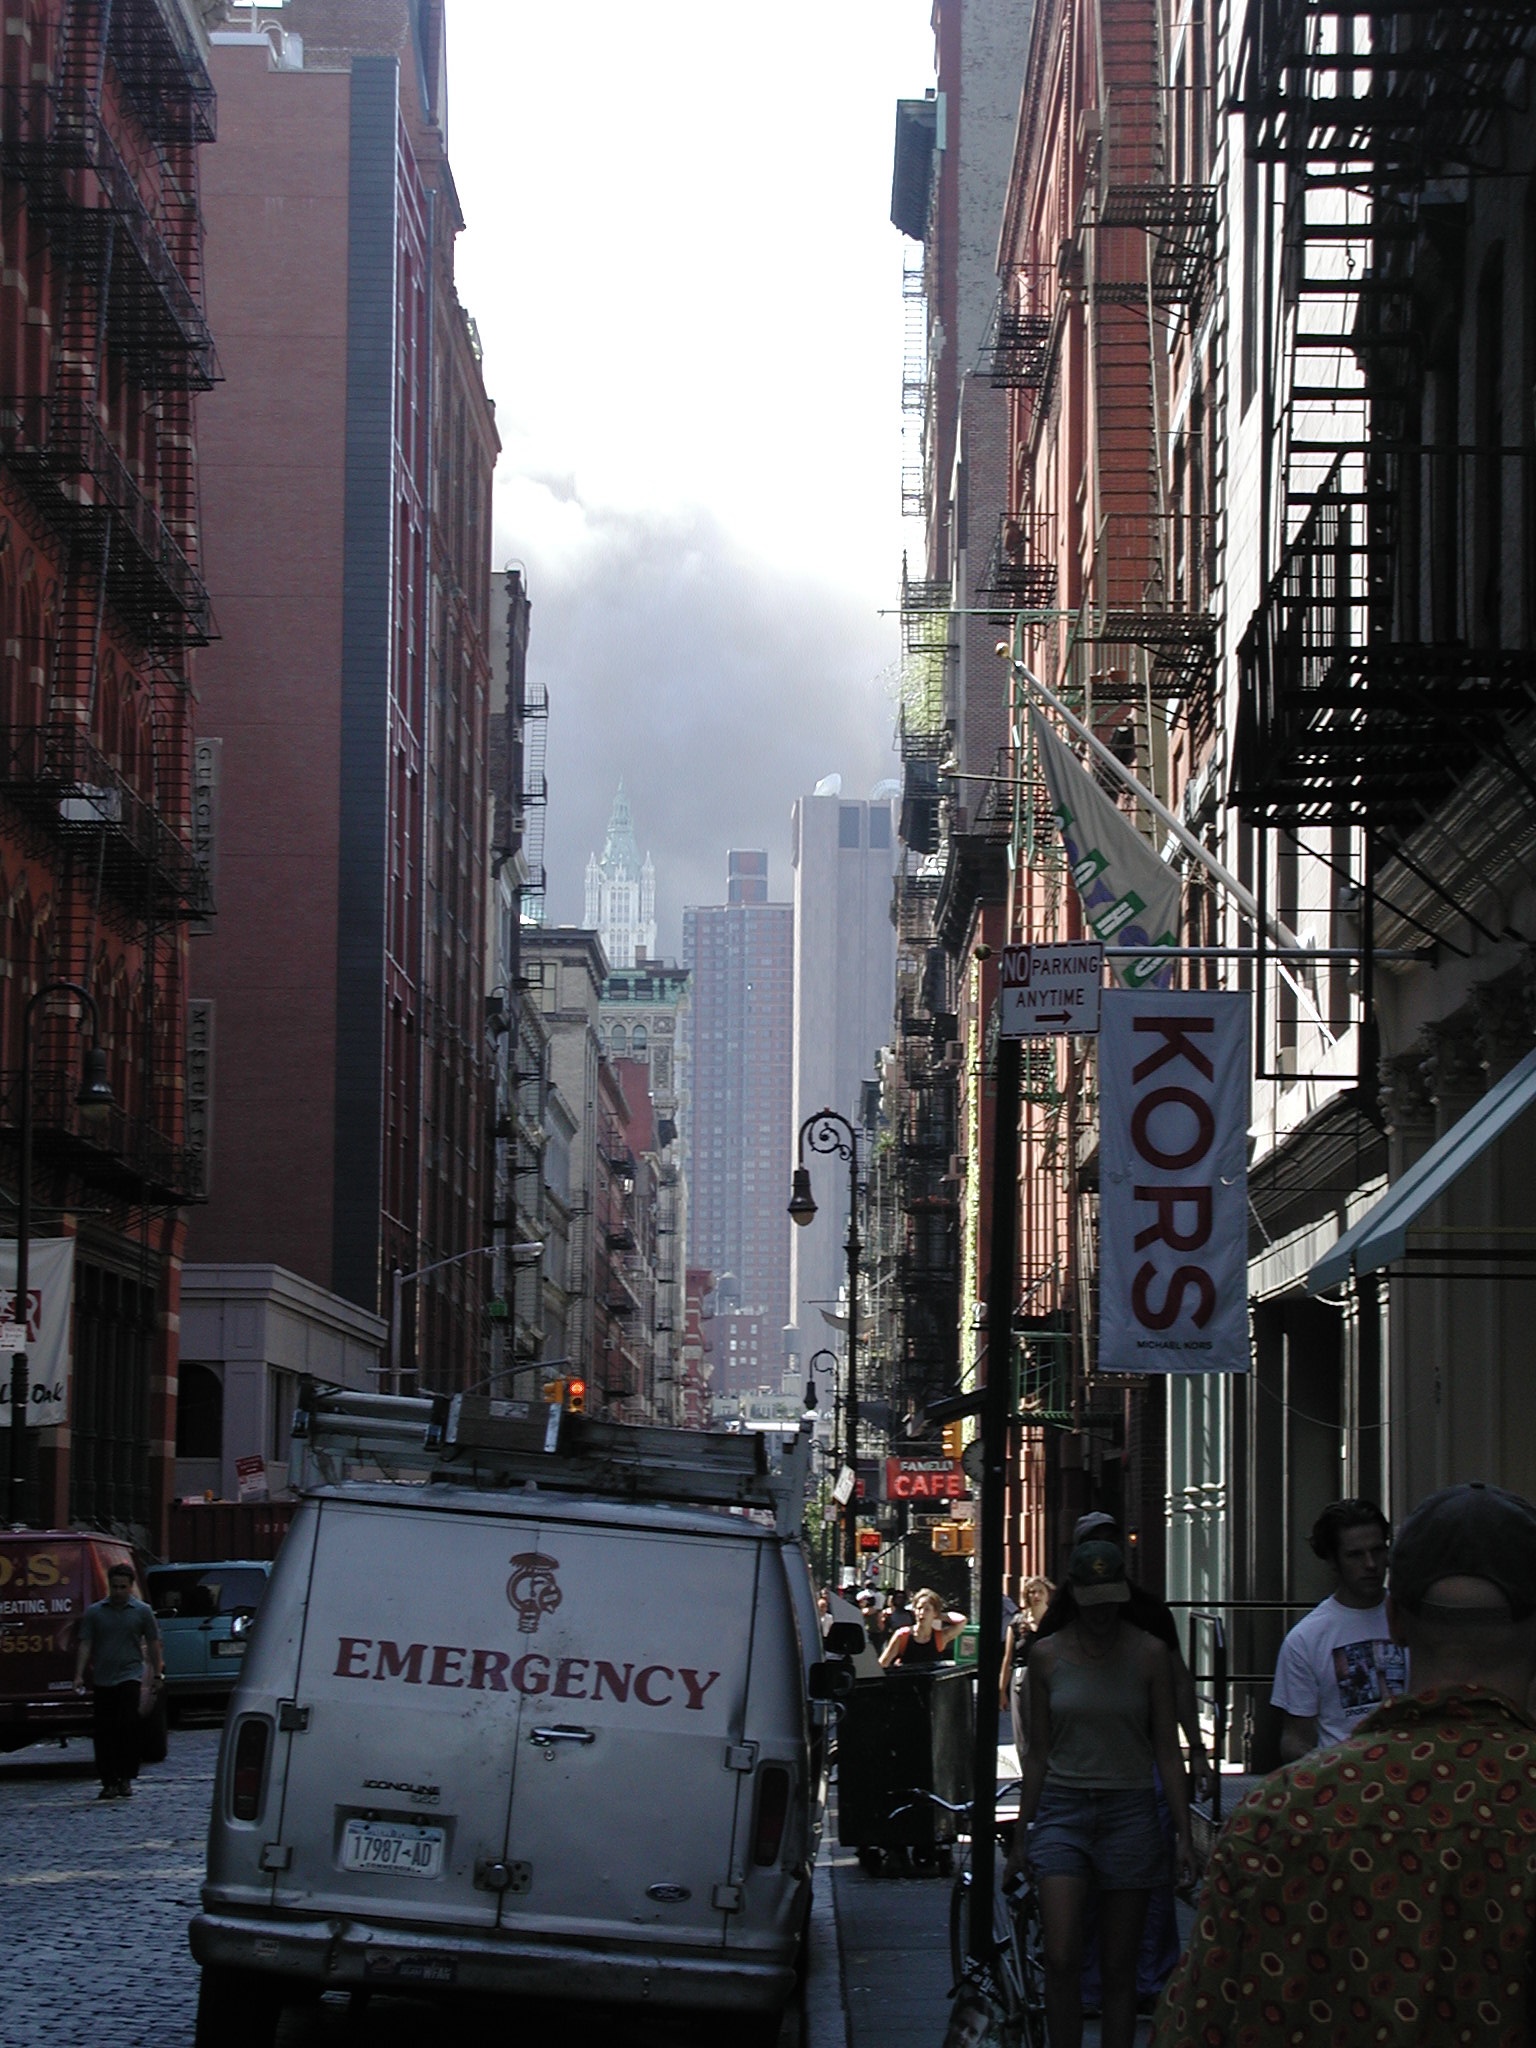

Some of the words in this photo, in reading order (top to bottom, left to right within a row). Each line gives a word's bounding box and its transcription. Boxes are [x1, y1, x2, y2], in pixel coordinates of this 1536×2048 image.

[1003, 951, 1029, 983] NO
[1032, 956, 1098, 976] PARKING
[1016, 988, 1084, 1008] ANYTIME
[192, 1010, 207, 1115] MUSEUM
[1131, 1017, 1216, 1330] KORS
[1137, 1341, 1181, 1350] MICHAEL
[1184, 1341, 1213, 1350] KORS
[893, 1475, 960, 1498] CAFE
[0, 1600, 48, 1615] EATING,
[51, 1598, 72, 1613] INC
[333, 1638, 721, 1711] EMERGENCY
